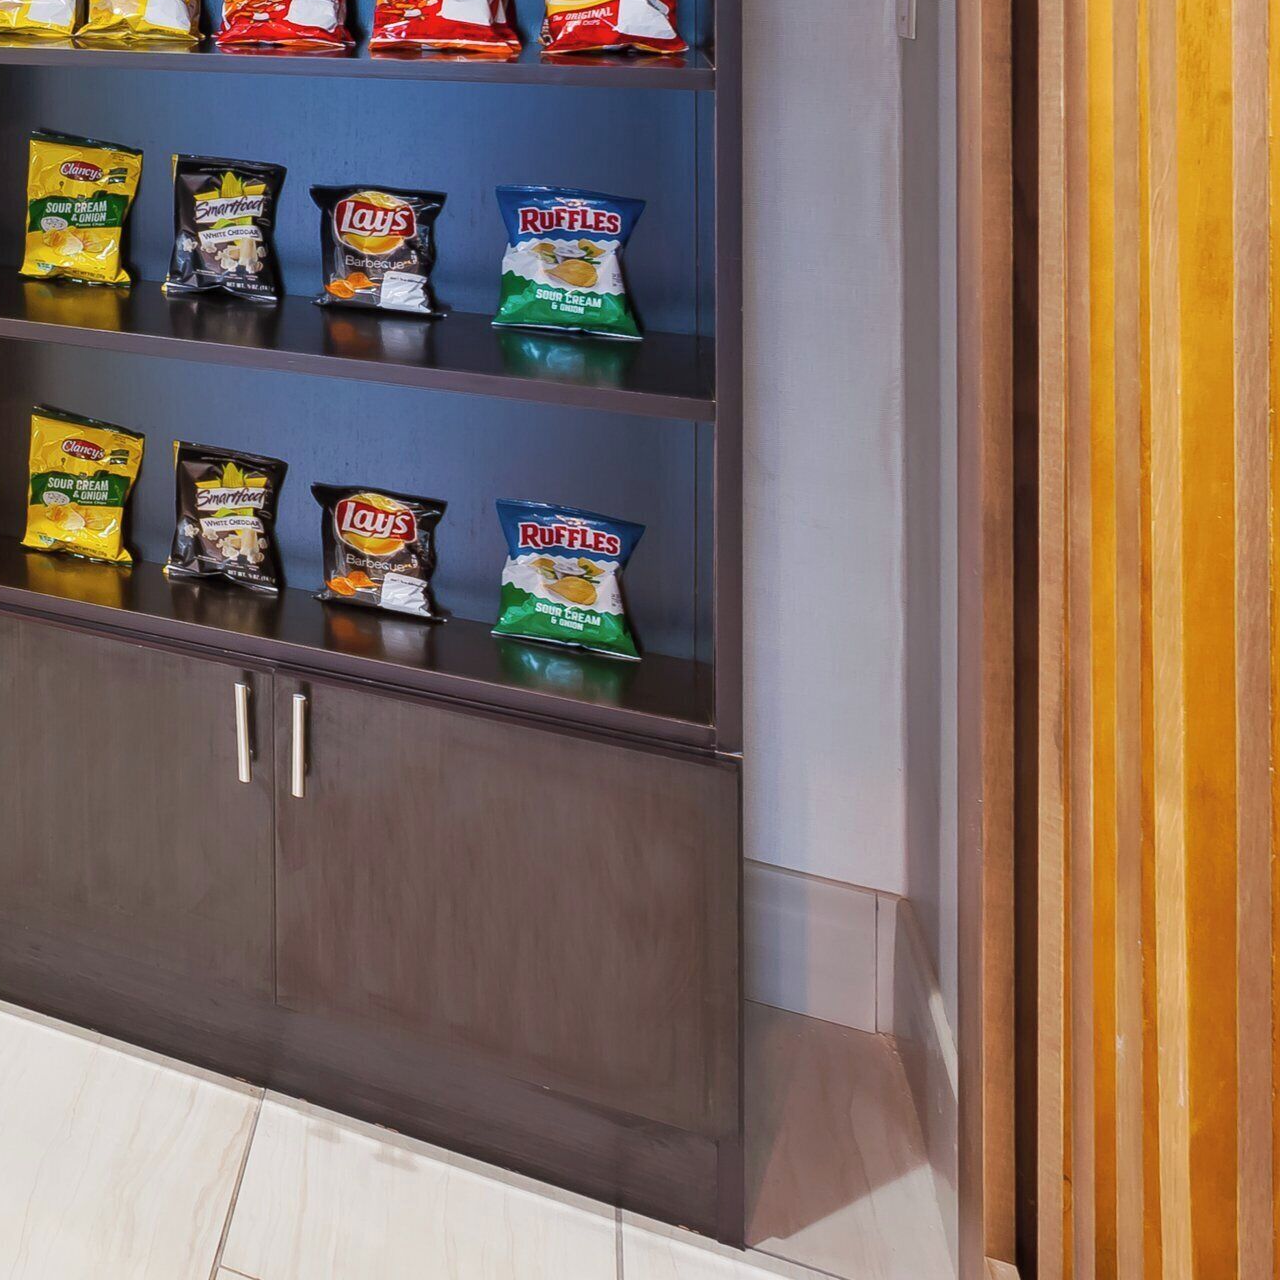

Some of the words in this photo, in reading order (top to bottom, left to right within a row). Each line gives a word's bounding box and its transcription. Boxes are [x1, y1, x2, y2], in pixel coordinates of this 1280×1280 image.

[61, 161, 103, 181] Clancy's
[46, 202, 72, 214] SOUR
[74, 201, 107, 213] CREAM
[71, 213, 77, 222] &
[79, 212, 107, 222] ONION
[195, 198, 264, 217] Smartfood
[341, 202, 410, 236] Lay's
[519, 207, 621, 234] RUFFLES
[202, 230, 226, 240] WHITE
[228, 228, 258, 237] CHEDDAR
[345, 255, 404, 270] Barbecue
[535, 289, 563, 301] SOUR
[566, 294, 601, 308] CREAM
[551, 303, 558, 311] &
[559, 304, 585, 314] ONION
[62, 439, 104, 459] Clancy's
[197, 490, 265, 506] Smartfood
[342, 501, 409, 538] Lay's
[518, 522, 621, 555] RUFFLES
